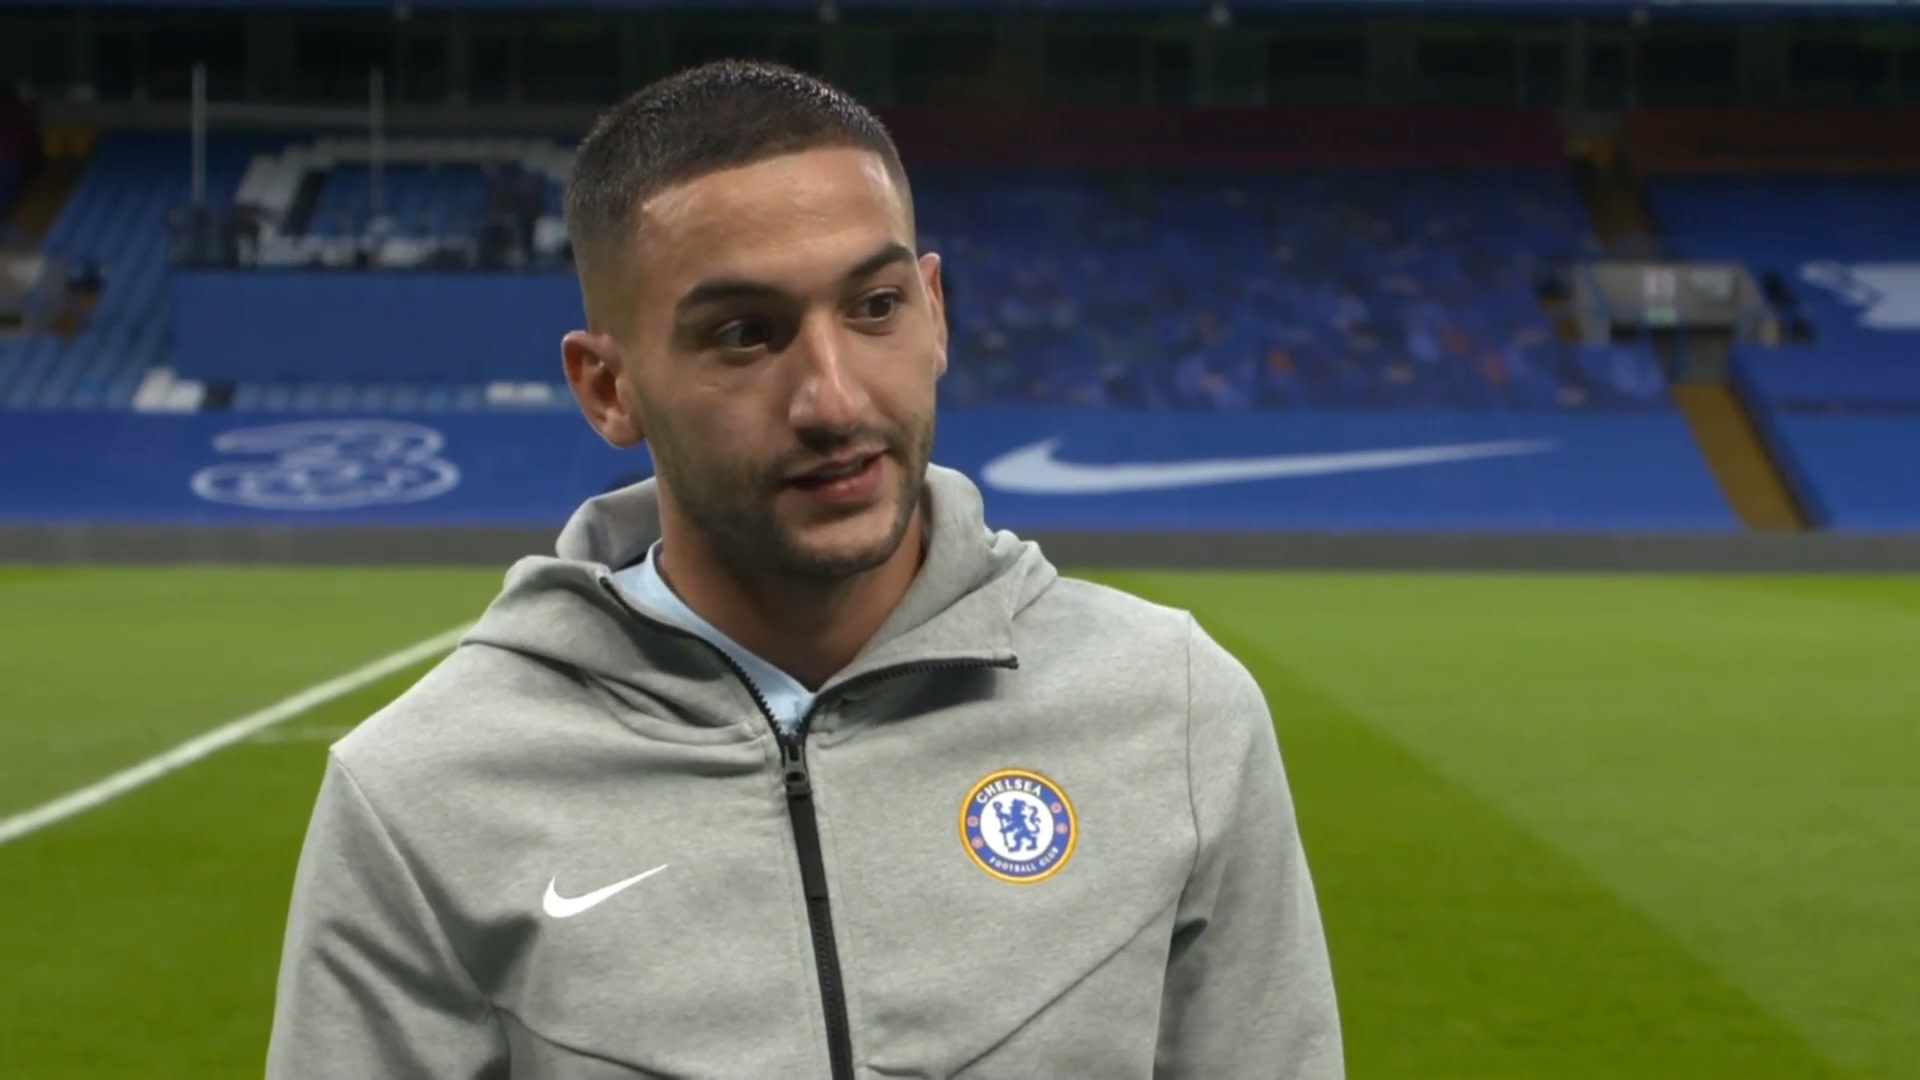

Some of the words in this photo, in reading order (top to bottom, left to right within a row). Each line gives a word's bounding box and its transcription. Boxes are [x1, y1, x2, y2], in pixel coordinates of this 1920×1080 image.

[976, 778, 1042, 803] CHELSEA
[989, 856, 1037, 873] FOOTBALL
[1039, 846, 1059, 867] CLUB
